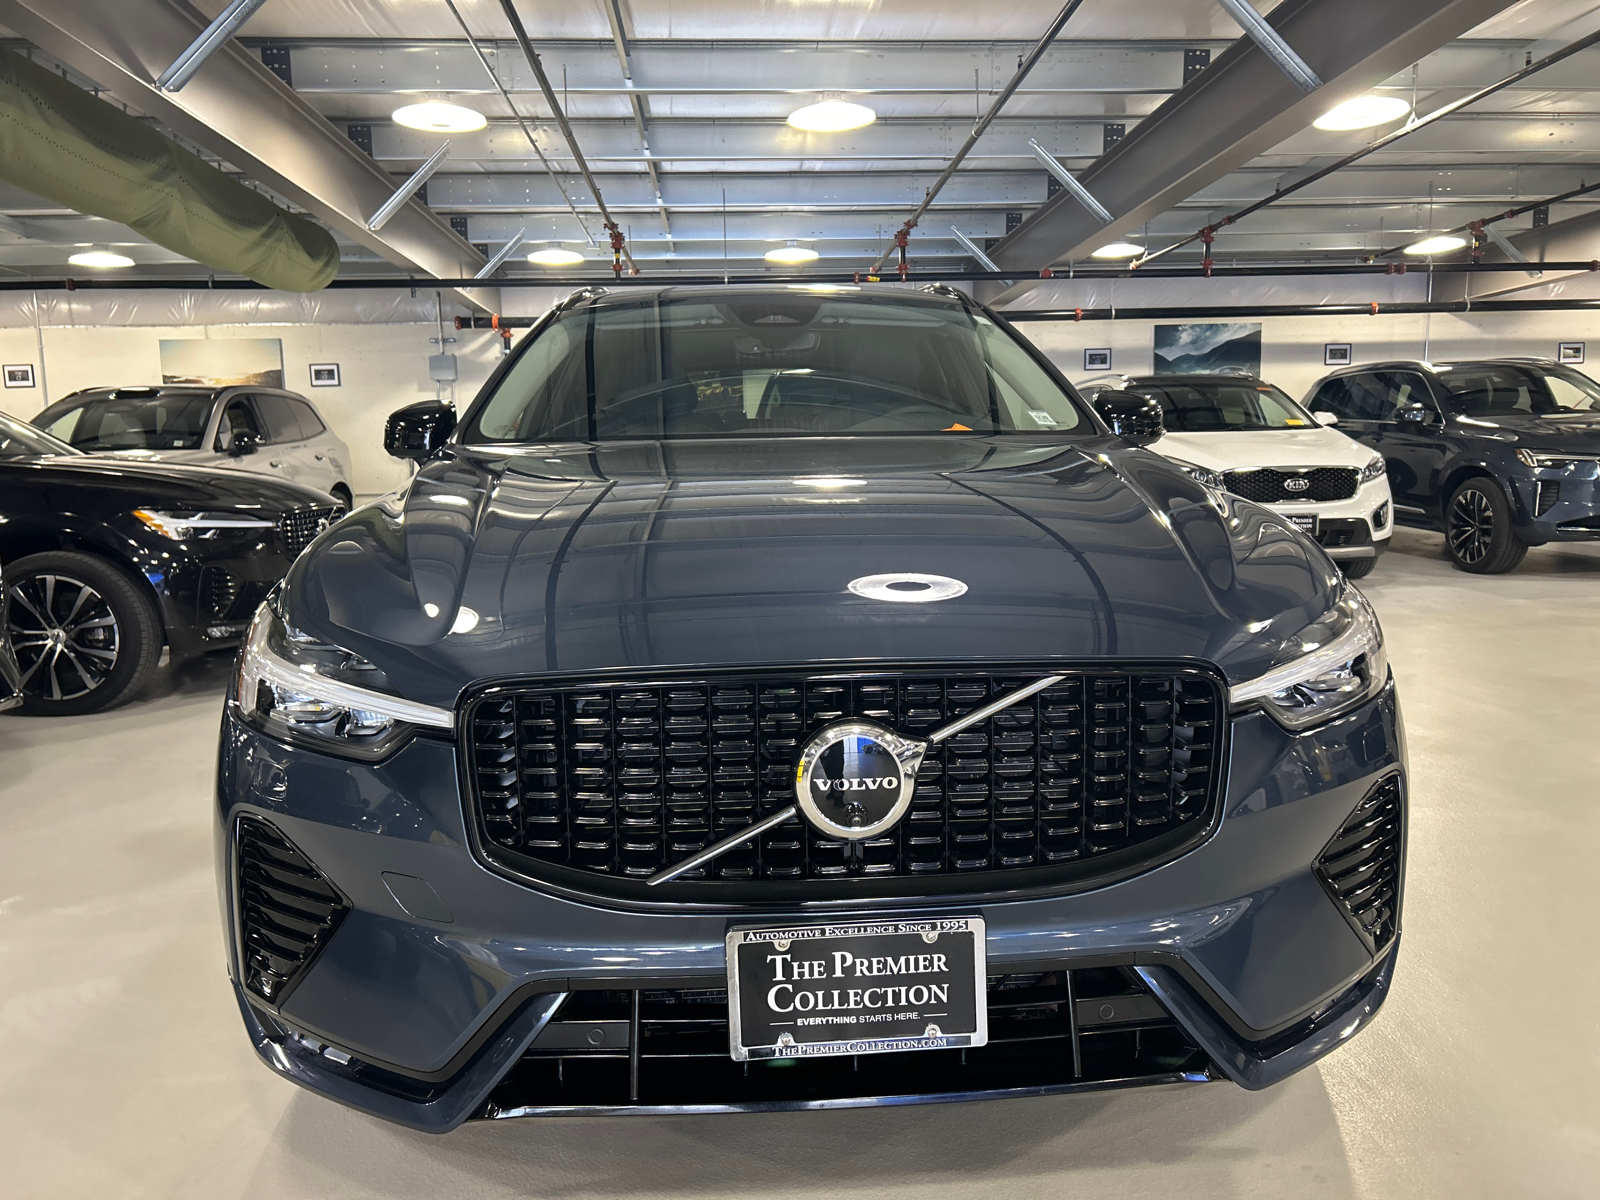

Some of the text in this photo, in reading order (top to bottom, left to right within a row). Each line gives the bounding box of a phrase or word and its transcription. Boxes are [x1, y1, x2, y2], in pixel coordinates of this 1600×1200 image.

[813, 777, 898, 791] VOLVO
[746, 920, 967, 942] AUTOMOTIVE EXCELLENCE SINCE 1995
[766, 951, 949, 981] THE PREMIER
[766, 983, 950, 1013] COLLECTION
[796, 1011, 921, 1026] EVERYTHING STARTS HERE.
